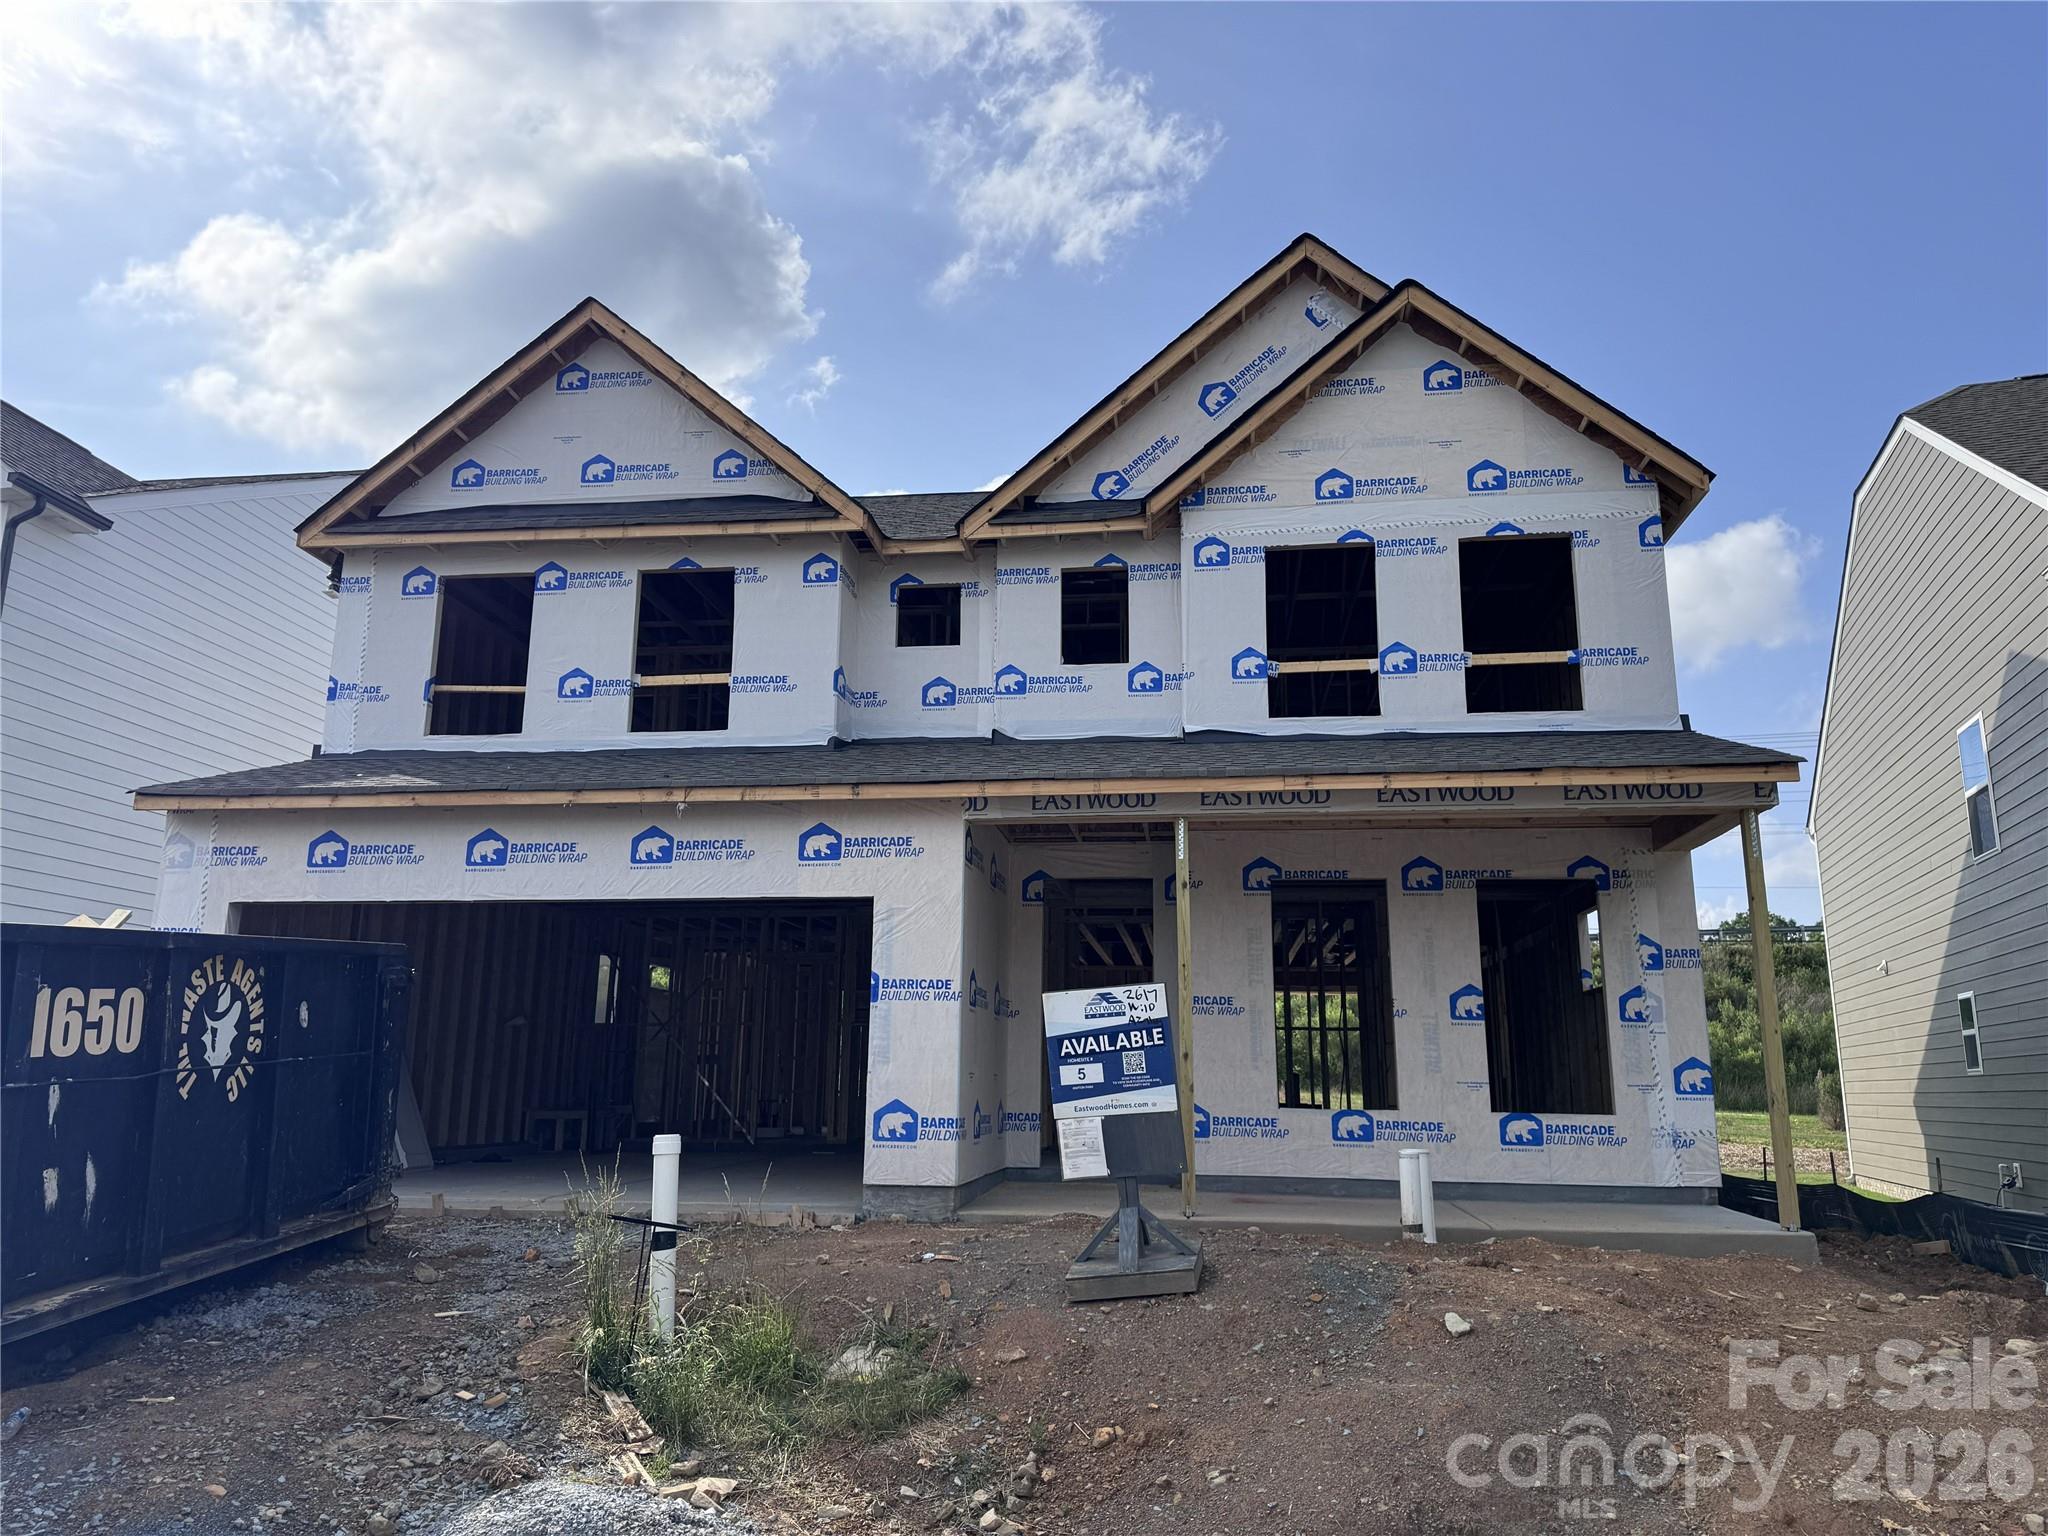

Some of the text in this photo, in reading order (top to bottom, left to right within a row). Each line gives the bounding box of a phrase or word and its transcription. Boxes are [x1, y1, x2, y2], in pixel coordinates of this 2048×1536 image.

[1228, 345, 1276, 387] BARRICADE
[1234, 346, 1288, 394] BUILDING WRAP
[591, 371, 644, 380] BARRICADE
[589, 379, 652, 388] BUILDING WRAP
[1324, 378, 1375, 388] RRICADE
[1359, 386, 1386, 395] WRAP
[1121, 434, 1169, 476] BARRICADE
[1127, 435, 1180, 483] BUILDING WRAP
[486, 469, 539, 478] BARRICADE
[617, 464, 670, 473] BARRICADE
[1509, 468, 1572, 479] BARRICADE
[485, 476, 548, 486] BUILDING WRAP
[615, 472, 679, 482] BUILDING WRAP
[1355, 476, 1417, 488] BARRICADE
[1508, 477, 1584, 488] BUILDING WRAP
[1207, 485, 1266, 495] BARRICADE
[1354, 485, 1428, 496] BUILDING WRAP
[1206, 494, 1278, 504] BUILDING WRAP
[1376, 538, 1436, 548] BARRICADE
[1573, 538, 1600, 548] WRAP
[1231, 546, 1267, 556] BARRI
[1376, 546, 1448, 558] BUILDING WRAP
[1231, 556, 1266, 565] BUILDIN
[997, 568, 1050, 576] BARRICADE
[1130, 563, 1181, 572] BARRICAD
[340, 576, 372, 585] RICADE
[569, 572, 624, 580] BARRICADE
[744, 574, 768, 584] WRAP
[996, 576, 1060, 585] BUILDING WRAP
[1129, 572, 1166, 582] BUILDING
[568, 578, 633, 589] BUILDING WRAP
[965, 590, 989, 598] WRAP
[1582, 647, 1638, 658] ARRICADE
[1582, 656, 1650, 667] UILDING WRAP
[1419, 662, 1464, 672] BUILDING
[595, 679, 637, 688] BARRIC
[732, 676, 788, 685] BARRICADE
[1028, 676, 1084, 685] BARRICADE
[732, 684, 797, 693] BUILDING WRAP
[958, 687, 994, 696] BARRIC
[1028, 684, 1093, 694] BUILDING WRAP
[1164, 682, 1182, 691] BUIL
[594, 688, 632, 697] BUILDING
[366, 694, 390, 702] WRAP
[957, 696, 995, 704] BUILDING
[863, 700, 888, 708] WRAP
[676, 839, 744, 850] BARRICADE
[844, 836, 912, 848] BARRICADE
[350, 844, 414, 854] BARRICADE
[510, 842, 576, 854] BARRICADE
[842, 847, 924, 859] BUILDING WRAP
[240, 856, 268, 866] WRAP
[348, 854, 425, 866] BUILDING WRAP
[508, 852, 588, 864] BUILDING WRAP
[674, 850, 755, 862] BUILDING WRAP
[1284, 870, 1350, 880] BARRICADE
[1445, 869, 1513, 879] BARRICADE
[1444, 880, 1477, 890] BUILD
[1665, 949, 1700, 959] BARRI
[1665, 958, 1702, 969] BUILDIN
[882, 978, 952, 990] BARRICADE
[880, 990, 930, 1001] BUILDING
[230, 958, 265, 1054] AGENTS
[1193, 996, 1234, 1006] RICADE
[1084, 1003, 1126, 1014] EASTWOOD
[1192, 1006, 1245, 1016] DING WRAP
[30, 986, 145, 1058] 1650
[1060, 1028, 1164, 1056] AVAILABLE
[1078, 1068, 1086, 1080] 5
[1074, 1102, 1149, 1113] EastwoodHomes.com
[1003, 1112, 1041, 1122] RICAD
[1213, 1116, 1278, 1128] BARRICADE
[921, 1117, 962, 1129] BARRI
[1376, 1120, 1444, 1132] BARRICADE
[1212, 1127, 1290, 1139] BUILDING WRAP
[1546, 1124, 1615, 1136] BARRICADE
[919, 1130, 962, 1141] BUILDIN
[1375, 1132, 1456, 1144] BUILDING WRAP
[1545, 1135, 1628, 1147] BUILDING WRAP
